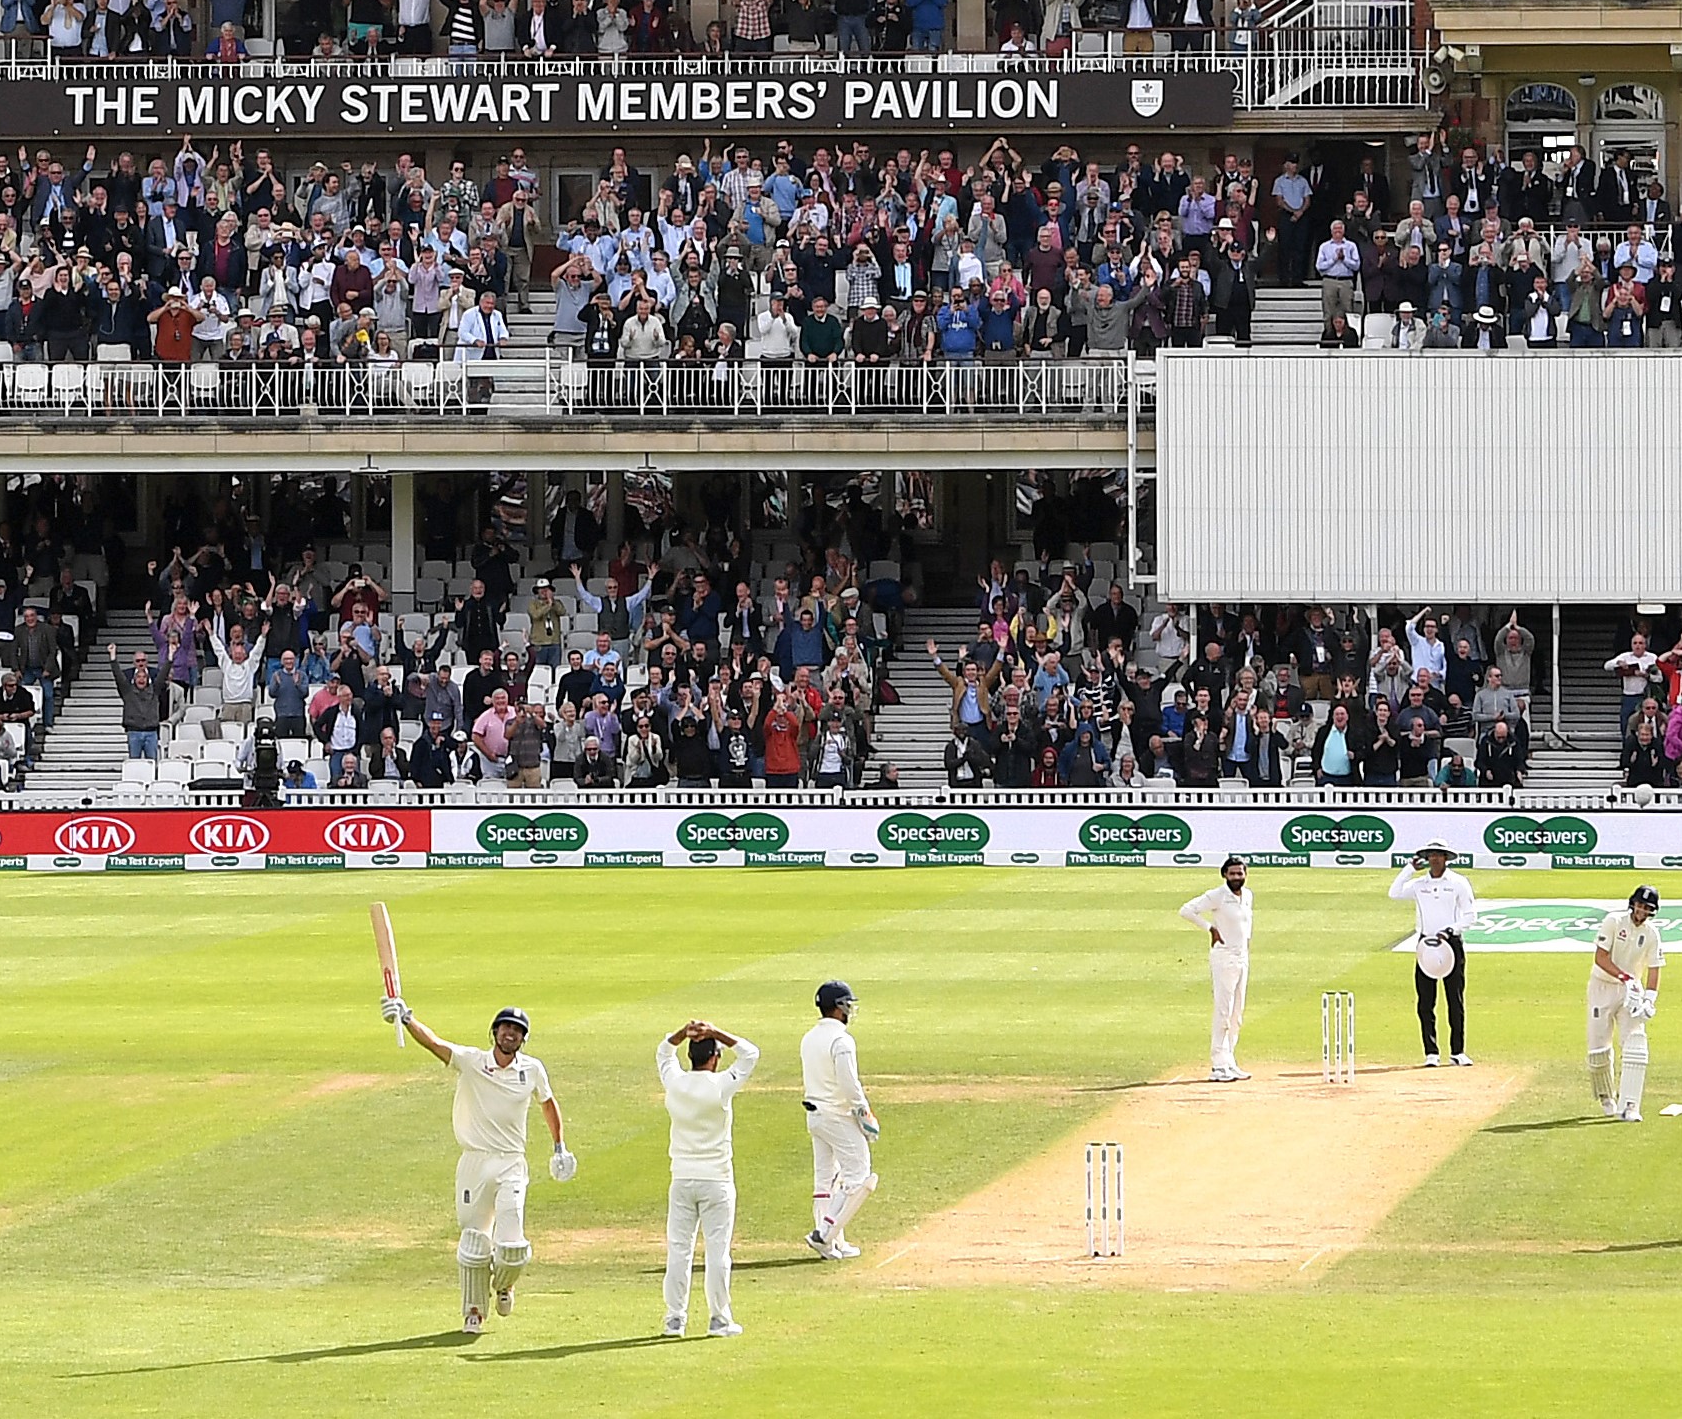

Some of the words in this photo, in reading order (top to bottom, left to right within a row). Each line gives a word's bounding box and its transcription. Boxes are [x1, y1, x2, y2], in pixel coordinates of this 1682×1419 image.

[66, 87, 158, 124] THE
[178, 85, 324, 124] MICKY
[341, 84, 559, 122] STEWART
[845, 80, 1057, 118] PAVILION
[69, 826, 121, 848] KIA
[204, 825, 255, 847] KIA
[339, 824, 390, 846] KIA
[487, 825, 578, 844] Specsavers
[687, 824, 778, 843] Specsavers
[887, 825, 979, 844] Specsavers
[1090, 825, 1181, 844] Specsavers
[1292, 826, 1383, 846] Specsavers
[1494, 828, 1586, 847] Specsavers
[108, 857, 127, 865] The
[128, 857, 146, 865] Test
[148, 857, 183, 866] Experts
[267, 856, 286, 864] The
[287, 856, 305, 864] Test
[307, 856, 342, 865] Experts
[587, 855, 605, 863] The
[606, 855, 624, 863] Test
[626, 855, 660, 864] Experts
[909, 853, 926, 861] The
[928, 853, 946, 861] Test
[948, 854, 982, 863] Experts
[1070, 854, 1087, 863] The
[1089, 854, 1107, 862] Test
[1109, 854, 1143, 863] Experts
[1251, 855, 1270, 864] Test
[1272, 855, 1307, 865] Experts
